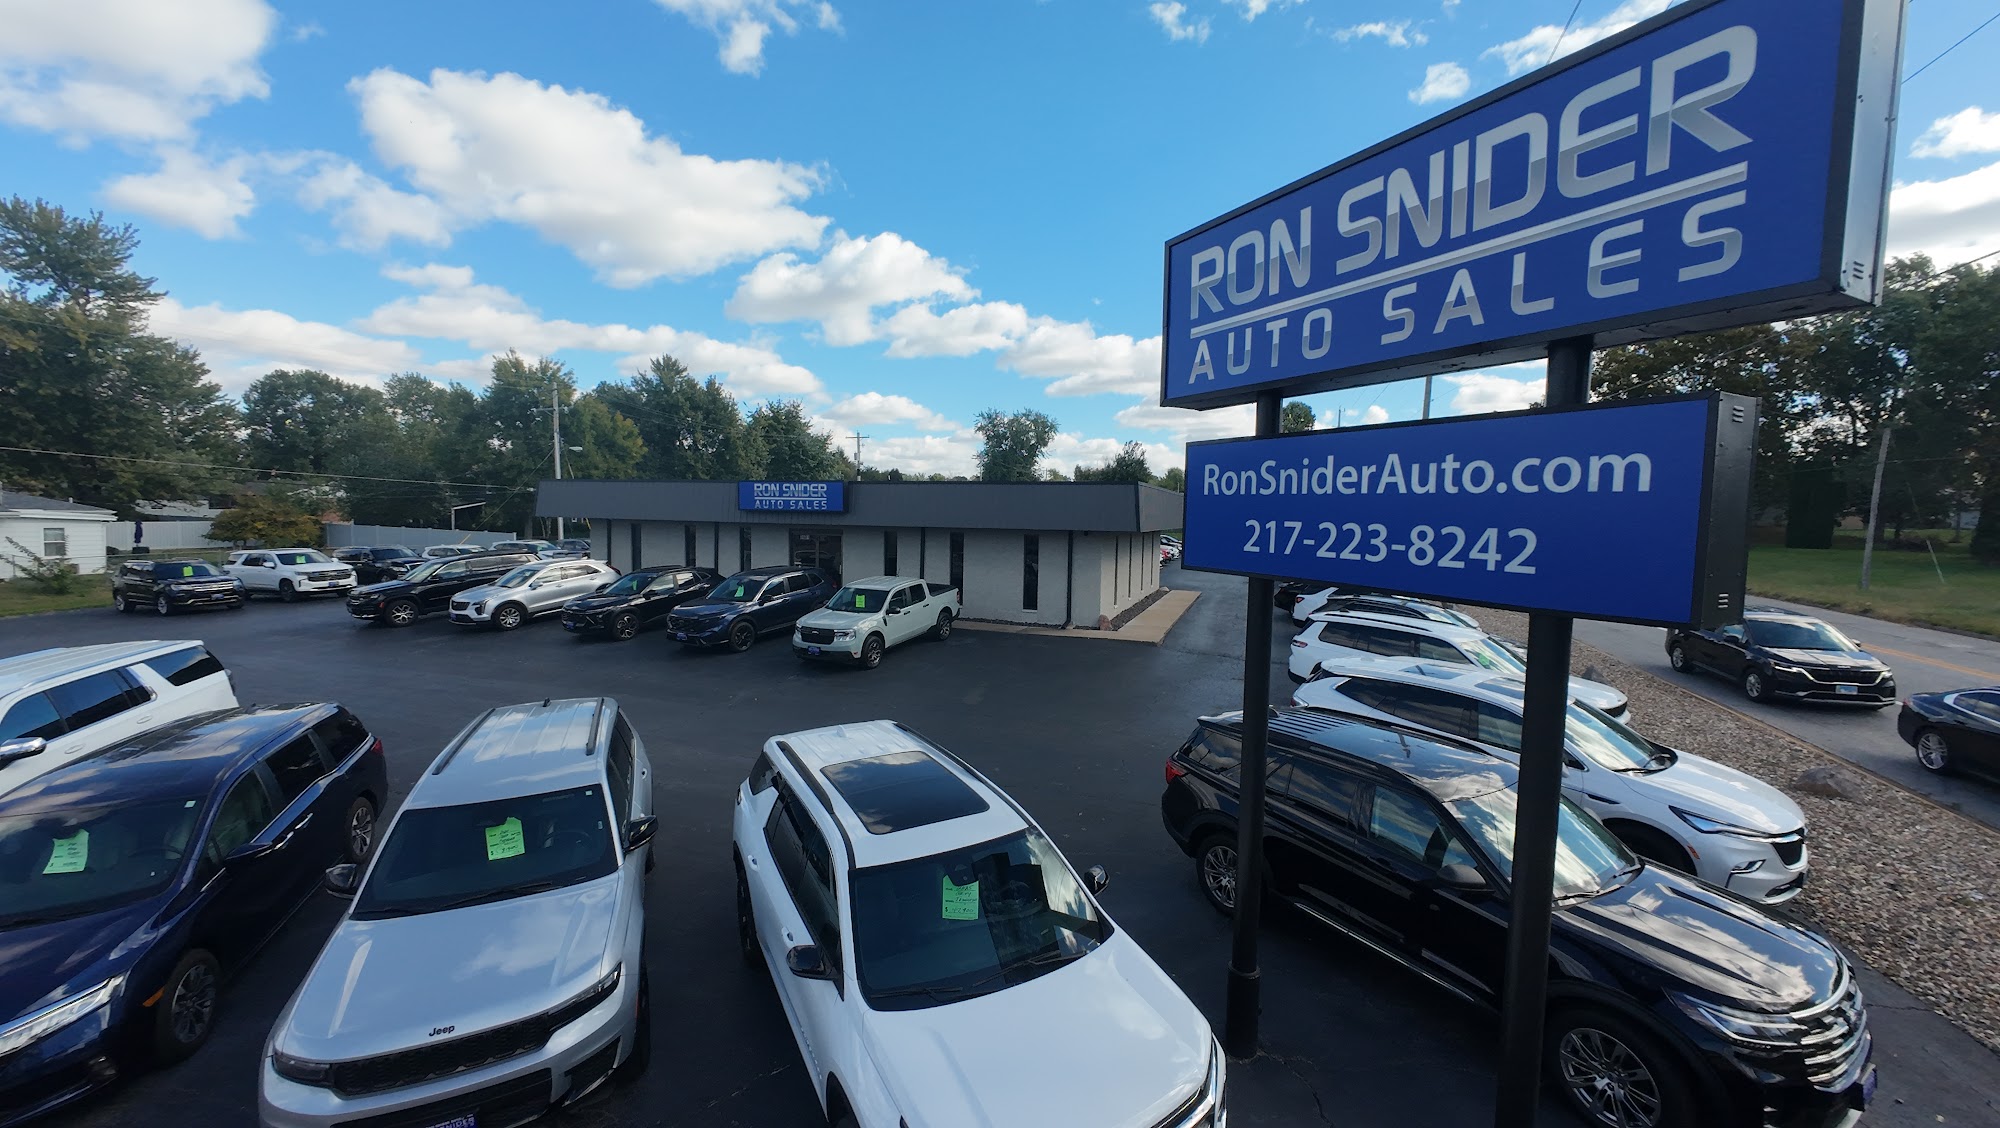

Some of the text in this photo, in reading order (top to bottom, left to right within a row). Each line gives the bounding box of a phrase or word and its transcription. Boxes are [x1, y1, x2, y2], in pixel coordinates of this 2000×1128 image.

[1190, 25, 1758, 321] RON SNIDER
[1188, 189, 1747, 385] AUTO SALES
[754, 483, 827, 498] RON SNIDER
[1203, 451, 1653, 495] RonSniderAuto.com
[754, 500, 828, 510] AUTO SALES
[1242, 519, 1538, 575] 217-223-8242
[428, 1025, 456, 1037] Jeep
